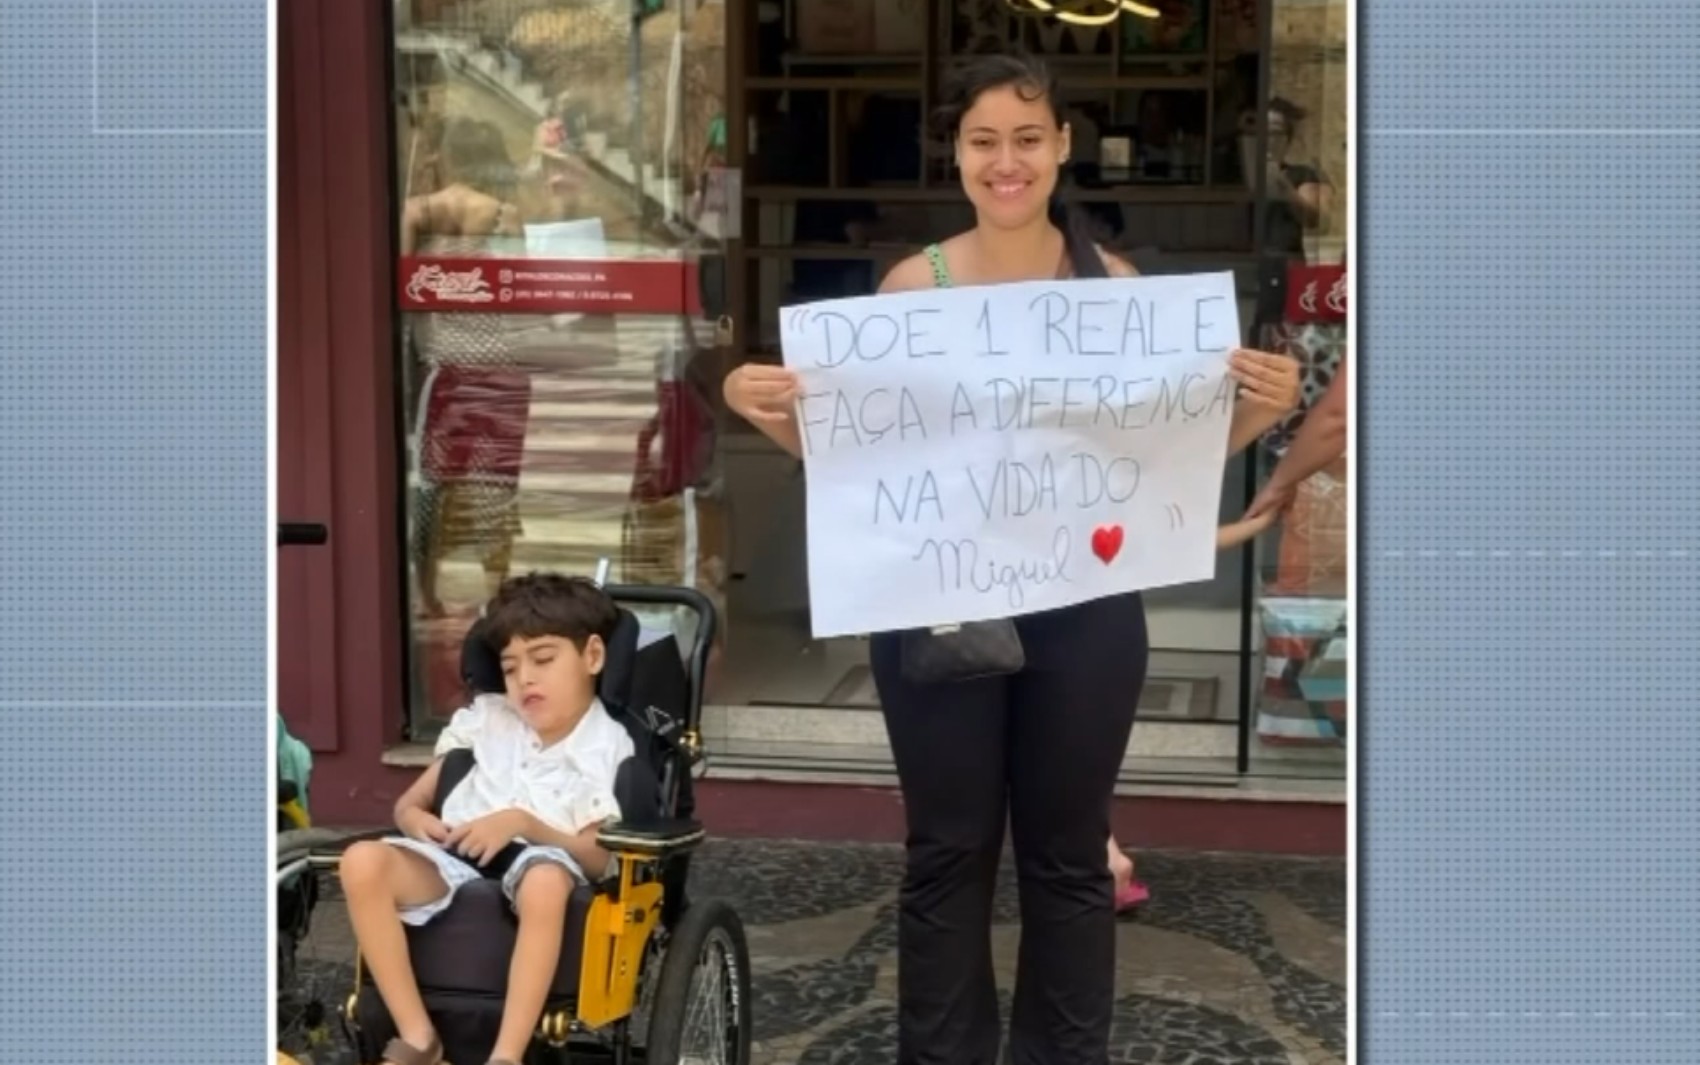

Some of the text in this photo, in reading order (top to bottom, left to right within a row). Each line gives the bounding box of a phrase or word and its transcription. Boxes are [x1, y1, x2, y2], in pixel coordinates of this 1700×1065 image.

[974, 297, 1009, 357] 1
[1028, 290, 1183, 358] REAL
[1195, 295, 1228, 353] E
[799, 386, 928, 457] FAÇA
[951, 381, 979, 437] A
[873, 452, 1141, 525] NA VIDA DO
[911, 525, 1075, 609] Miguel
